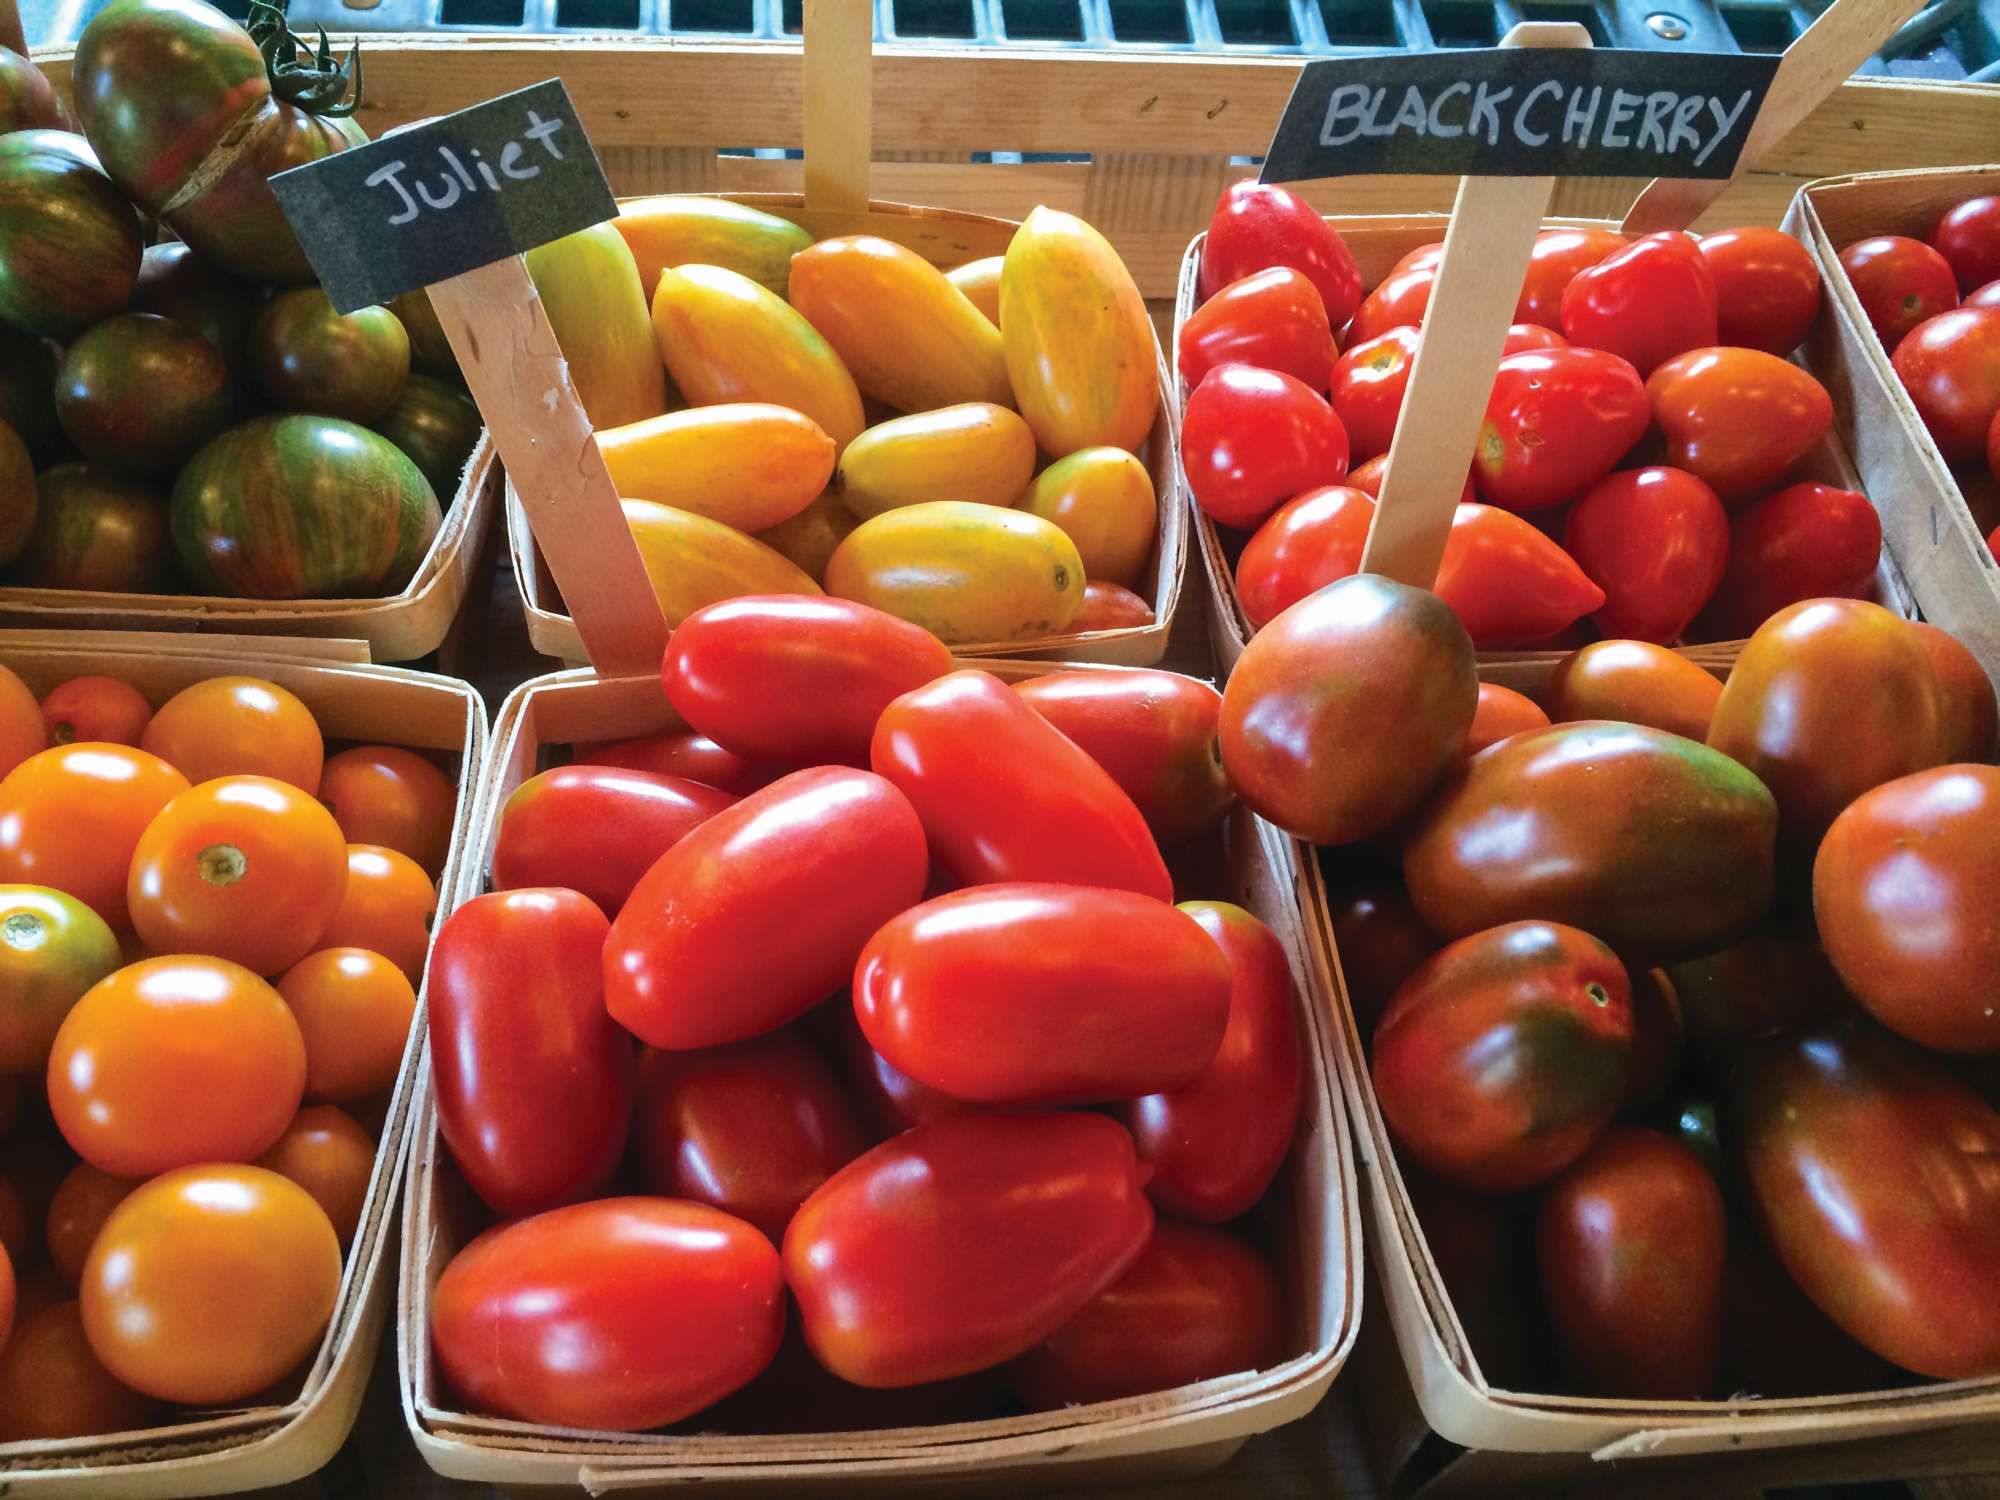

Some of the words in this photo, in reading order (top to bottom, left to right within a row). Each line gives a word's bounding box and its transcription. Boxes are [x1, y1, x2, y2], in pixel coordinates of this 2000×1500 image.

[365, 110, 564, 226] Juliet
[1319, 82, 1512, 147] BLACK
[1514, 80, 1752, 167] CHERRY
